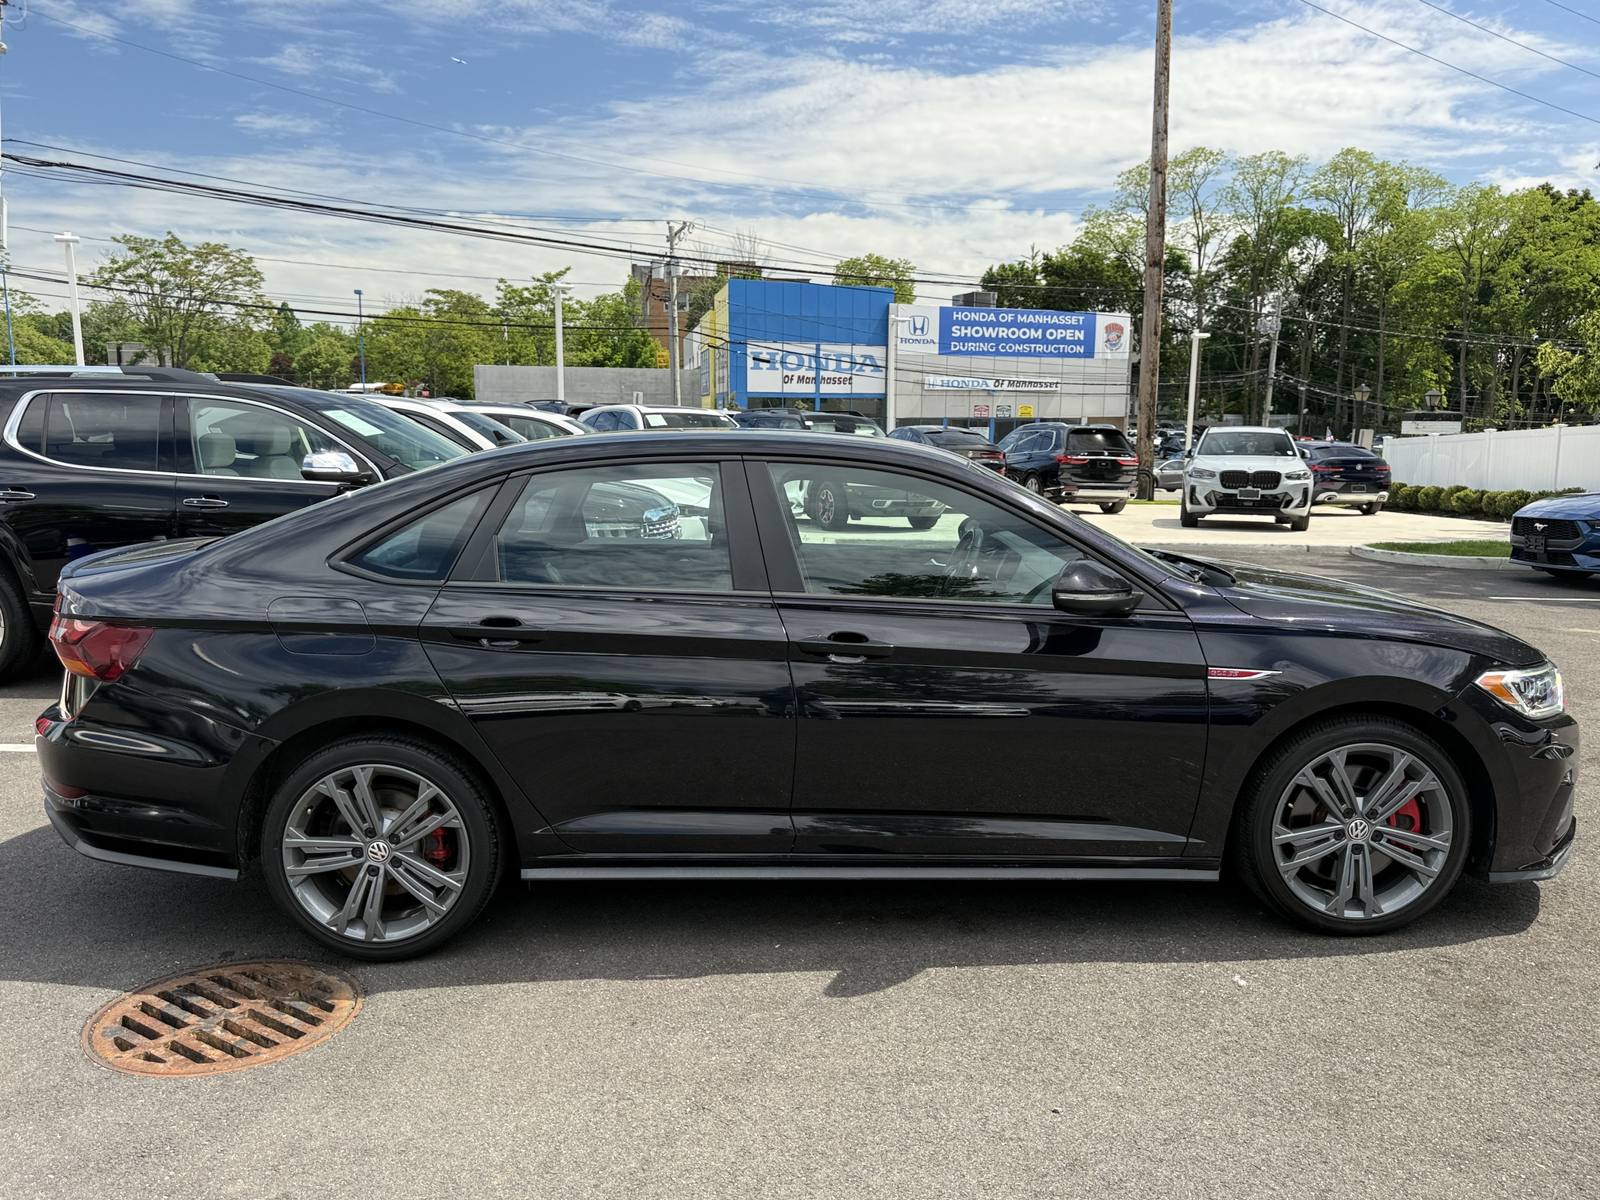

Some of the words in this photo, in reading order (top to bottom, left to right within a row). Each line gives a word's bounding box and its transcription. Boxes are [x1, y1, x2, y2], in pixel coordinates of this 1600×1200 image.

[953, 311, 996, 322] HONDA
[998, 312, 1015, 322] OF
[1017, 314, 1085, 325] MANHASSET
[951, 326, 1042, 339] SHOWROOM
[1045, 328, 1084, 340] OPEN
[951, 342, 996, 352] DURING
[999, 343, 1084, 354] CONSTRUCTION
[750, 351, 883, 373] HONDA
[796, 374, 853, 385] Manhasset
[940, 380, 990, 389] HONDA
